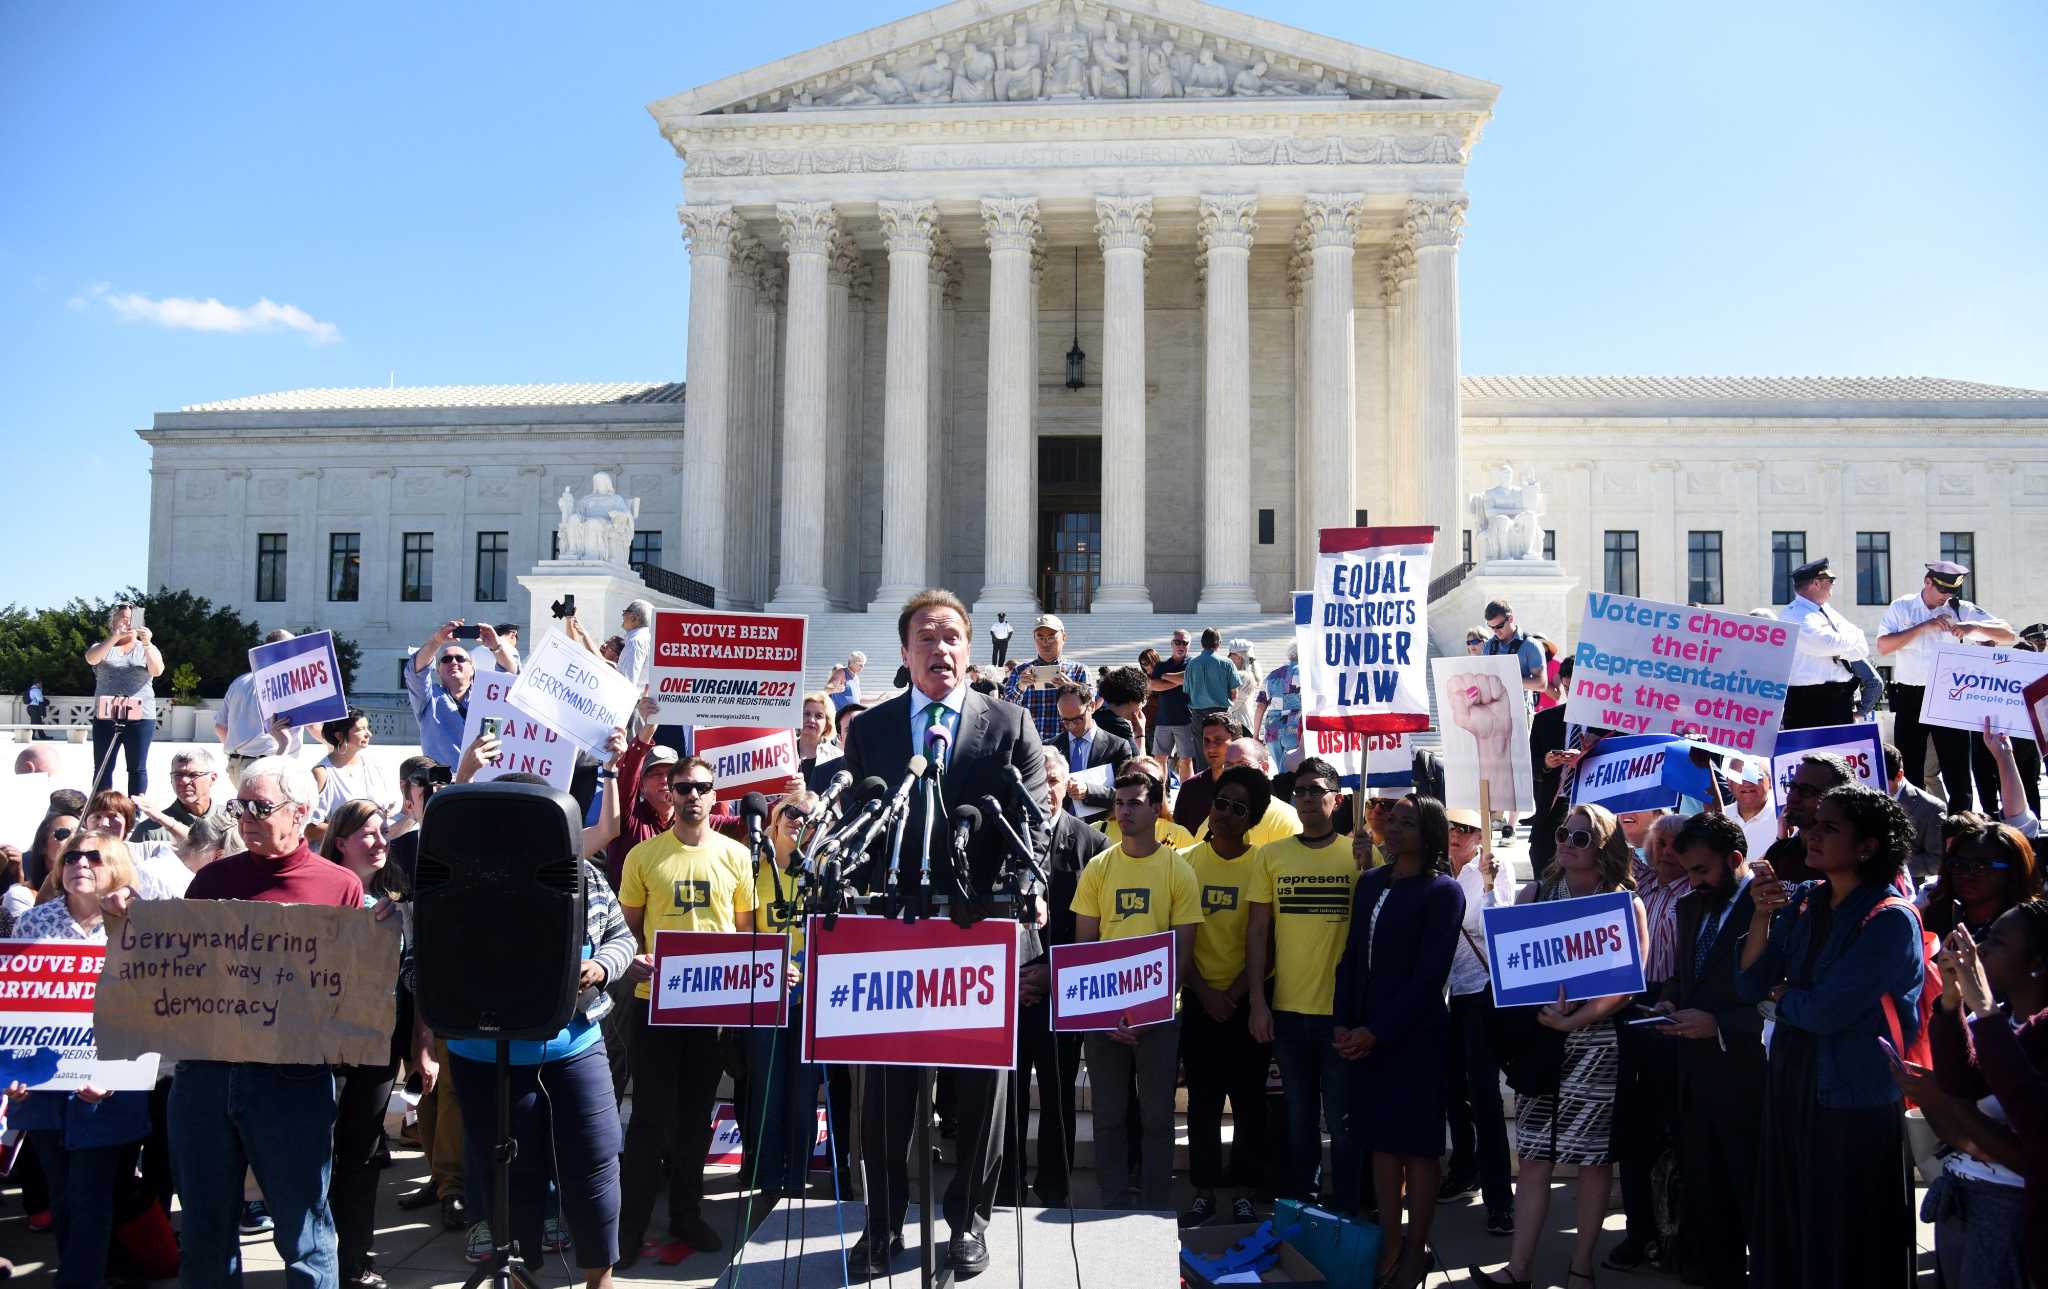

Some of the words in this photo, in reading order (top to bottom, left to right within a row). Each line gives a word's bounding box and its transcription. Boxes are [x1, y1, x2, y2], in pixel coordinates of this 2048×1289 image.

[1332, 560, 1411, 599] EQUAL
[1324, 599, 1416, 627] DISTRICTS
[1588, 592, 1681, 629] Voters
[1688, 613, 1787, 646] choose
[682, 623, 736, 639] YOU'VE
[740, 625, 779, 640] BEEN
[659, 643, 798, 661] GERRYMANDERED!
[1325, 631, 1412, 666] UNDER
[1651, 633, 1723, 664] their
[261, 660, 329, 704] #FAIRMAPS
[564, 663, 599, 690] END
[1574, 642, 1788, 700] Representatives
[1952, 672, 2022, 694] VOTING
[528, 666, 618, 725] GERRYMANDERIN
[658, 694, 701, 704] VIRGINIANS
[701, 695, 716, 704] FOR
[718, 696, 736, 705] FAIR
[737, 697, 791, 707] REDISTRICTING
[659, 677, 796, 697] ONEVIRGINIA2021
[1337, 670, 1399, 706] LAW
[1966, 693, 2004, 703] people
[1576, 679, 1623, 704] not
[1635, 684, 1680, 712] the
[1694, 696, 1774, 726] other
[503, 720, 558, 743] AND
[1602, 709, 1652, 734] way
[1318, 731, 1401, 754] DISTRCTS!
[490, 752, 552, 776] RING
[1585, 752, 1664, 788] #FAIRMAP
[1277, 887, 1292, 895] us
[1278, 874, 1351, 885] represent
[121, 918, 318, 964] Gerrymandering
[1507, 924, 1622, 970] #FAIRMAPS
[79, 956, 106, 973] BE
[119, 957, 207, 980] another
[226, 964, 262, 984] way
[276, 967, 294, 985] to
[310, 969, 342, 997] rig
[668, 962, 774, 992] #FAIRMAPS
[829, 964, 995, 1012] #FAIRMAPS
[1066, 960, 1163, 1002] #FAIRMAPS
[154, 988, 279, 1026] democracy
[0, 1026, 95, 1046] VIRGINIA
